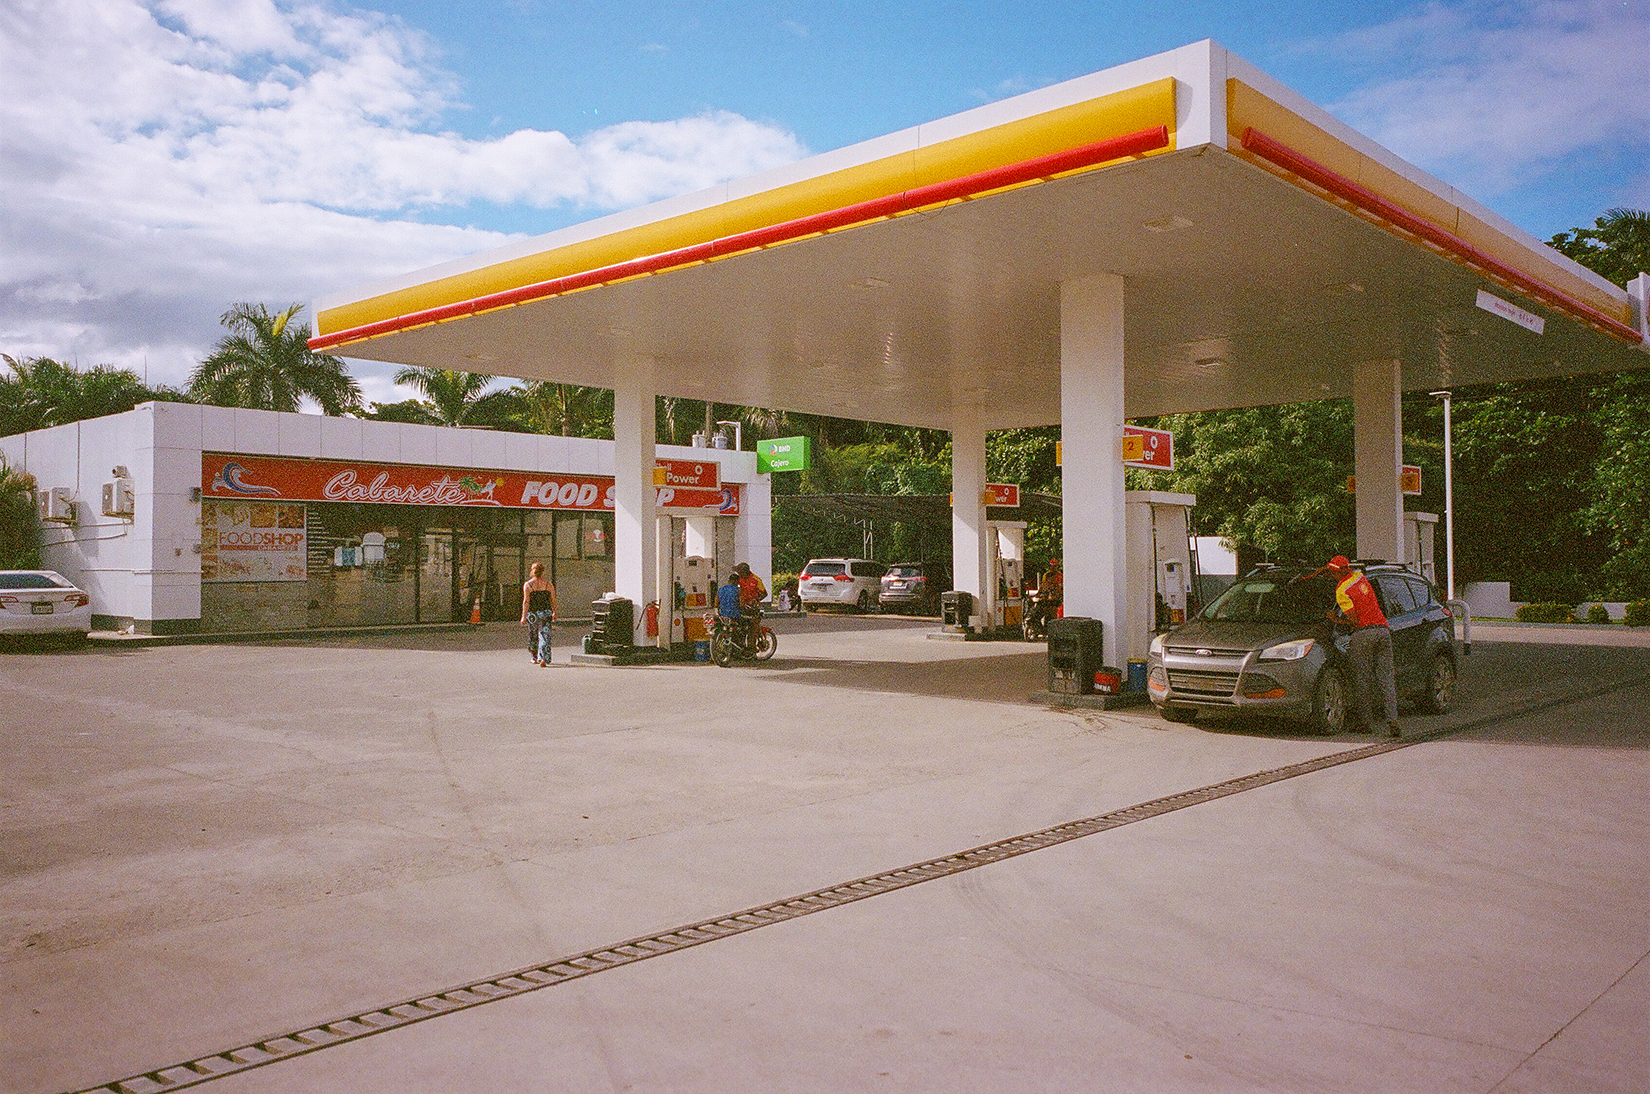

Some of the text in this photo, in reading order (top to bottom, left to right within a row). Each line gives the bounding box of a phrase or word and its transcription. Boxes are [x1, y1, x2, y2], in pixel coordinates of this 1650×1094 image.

[770, 459, 790, 469] Cajero
[666, 472, 699, 484] Power
[322, 469, 468, 503] Cabarete
[520, 480, 598, 506] FOOD
[219, 531, 304, 545] FOODSHOP
